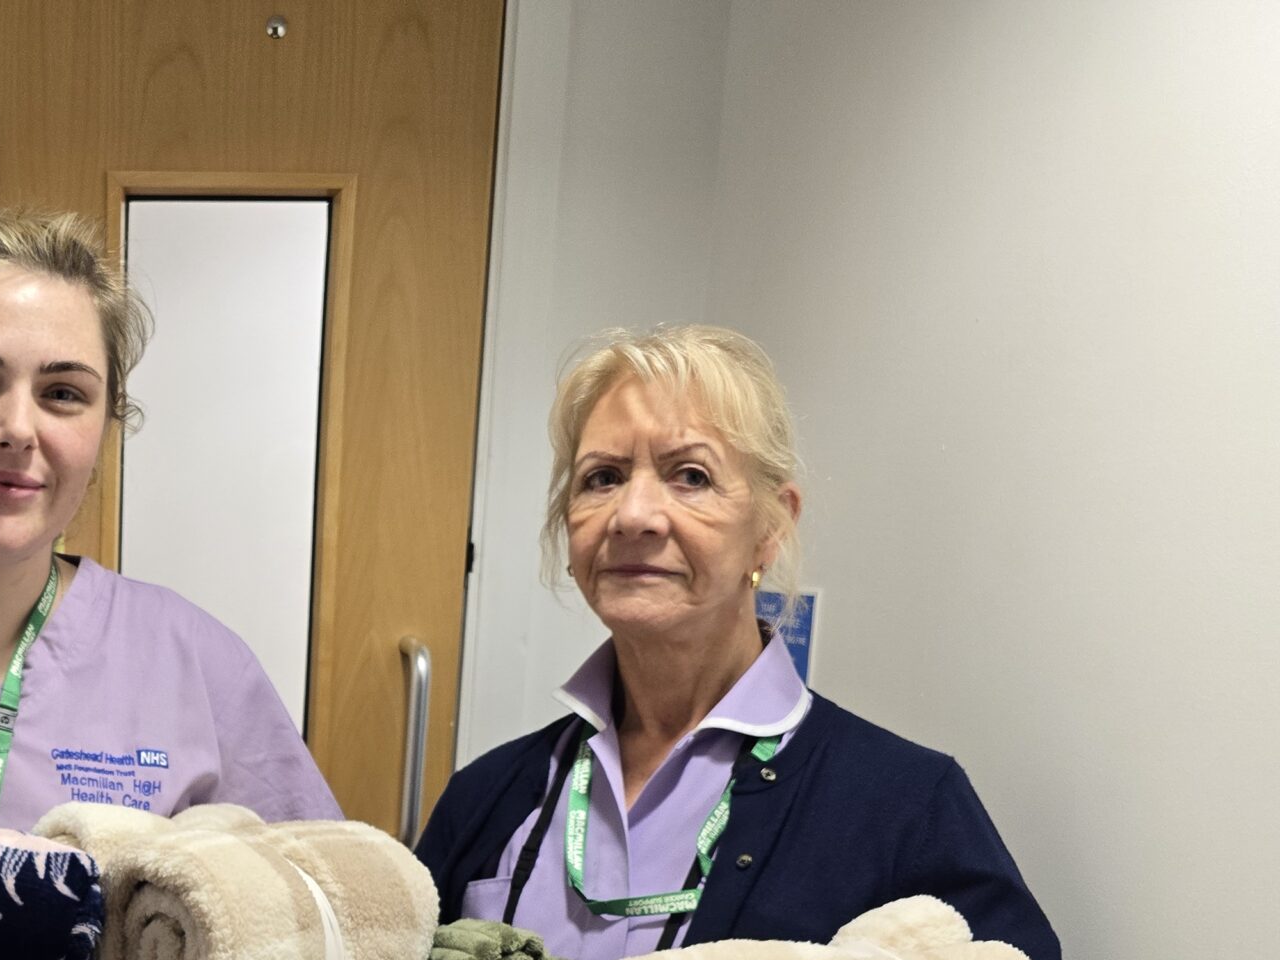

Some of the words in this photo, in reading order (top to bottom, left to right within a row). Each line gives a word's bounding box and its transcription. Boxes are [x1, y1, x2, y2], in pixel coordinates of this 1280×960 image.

[51, 748, 104, 763] Gateshead
[105, 753, 135, 766] Health
[139, 750, 168, 766] NHS
[56, 763, 73, 771] NHS
[74, 764, 115, 776] Foundation
[61, 773, 125, 791] Macmillan
[133, 779, 162, 797] H@H
[71, 788, 113, 804] Health
[122, 794, 150, 811] Care
[625, 899, 698, 915] MACMILLAN
